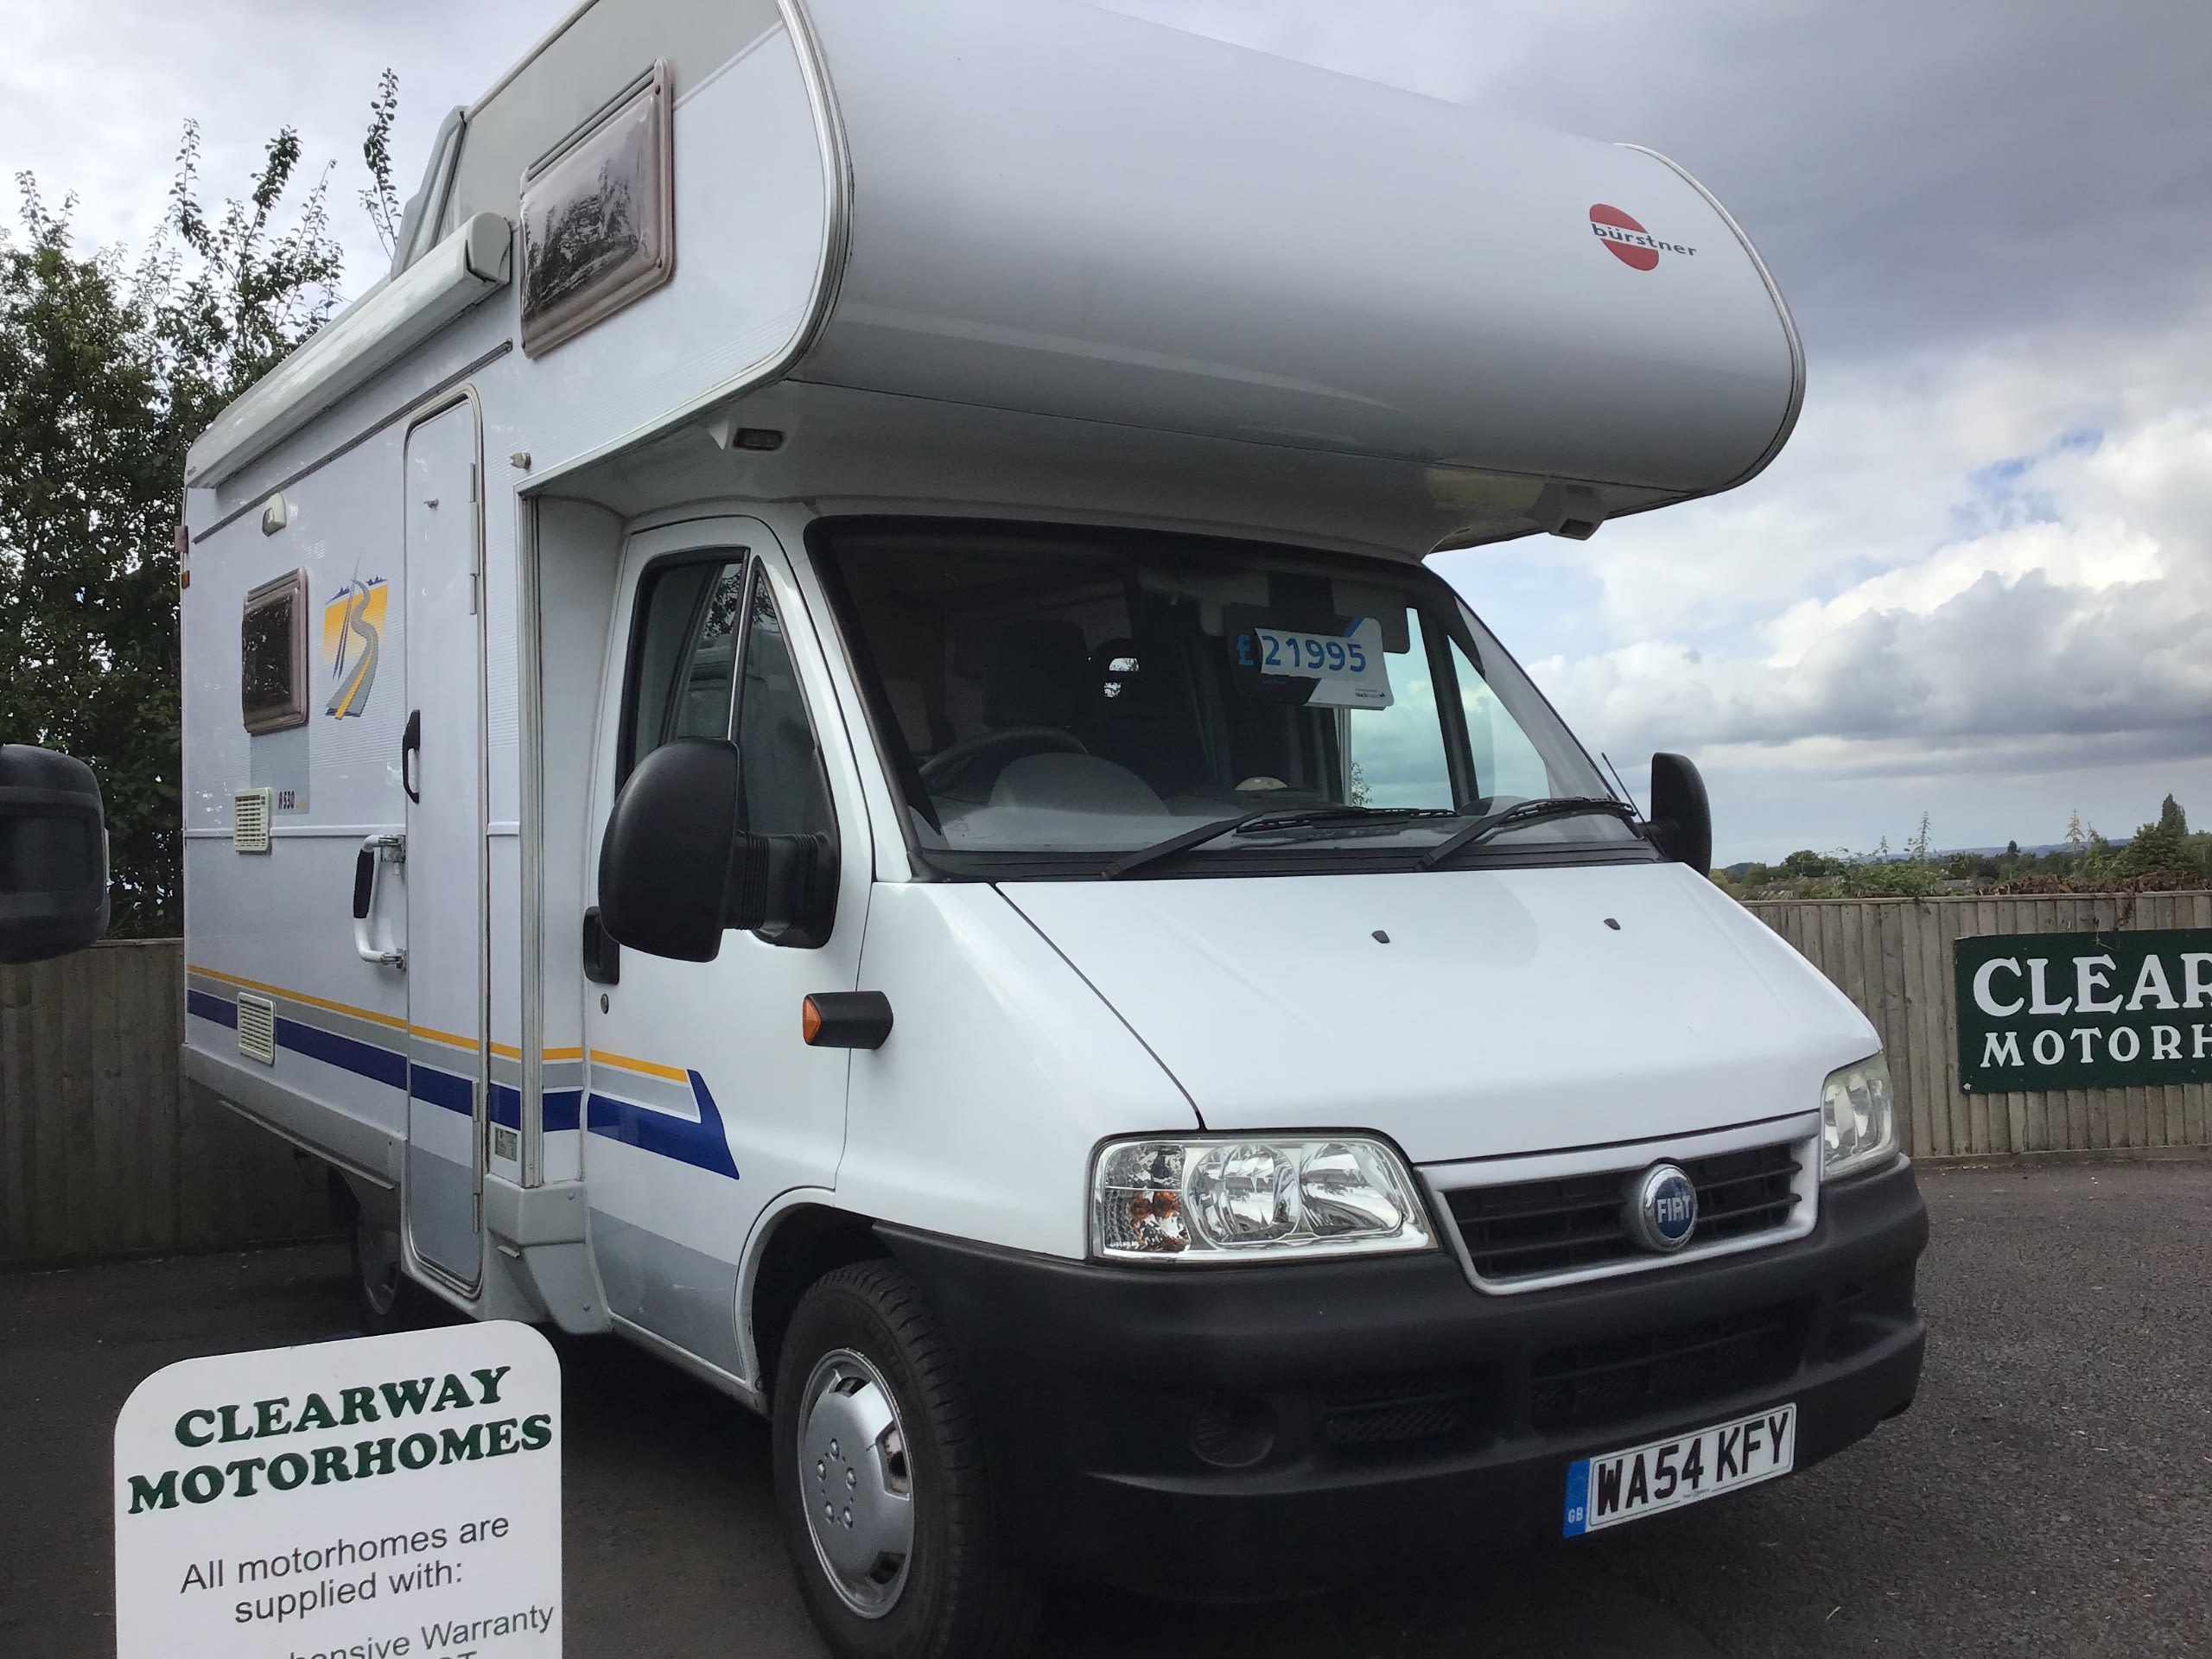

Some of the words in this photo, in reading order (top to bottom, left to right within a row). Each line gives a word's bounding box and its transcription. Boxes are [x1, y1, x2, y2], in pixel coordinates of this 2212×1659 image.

[1591, 223, 1697, 256] bürstner
[1656, 1194, 1691, 1224] FIAT
[175, 1365, 511, 1447] CLEARWAY
[127, 1414, 552, 1515] MOTORHOMES
[1597, 1437, 1704, 1516] WA54
[1716, 1411, 1789, 1483] KFY
[1568, 1507, 1583, 1524] GB
[180, 1560, 225, 1594] All
[238, 1524, 448, 1584] motorhomes
[459, 1516, 510, 1544] are
[234, 1572, 378, 1624] supplied
[389, 1560, 463, 1593] with:
[421, 1605, 555, 1650] Warranty
